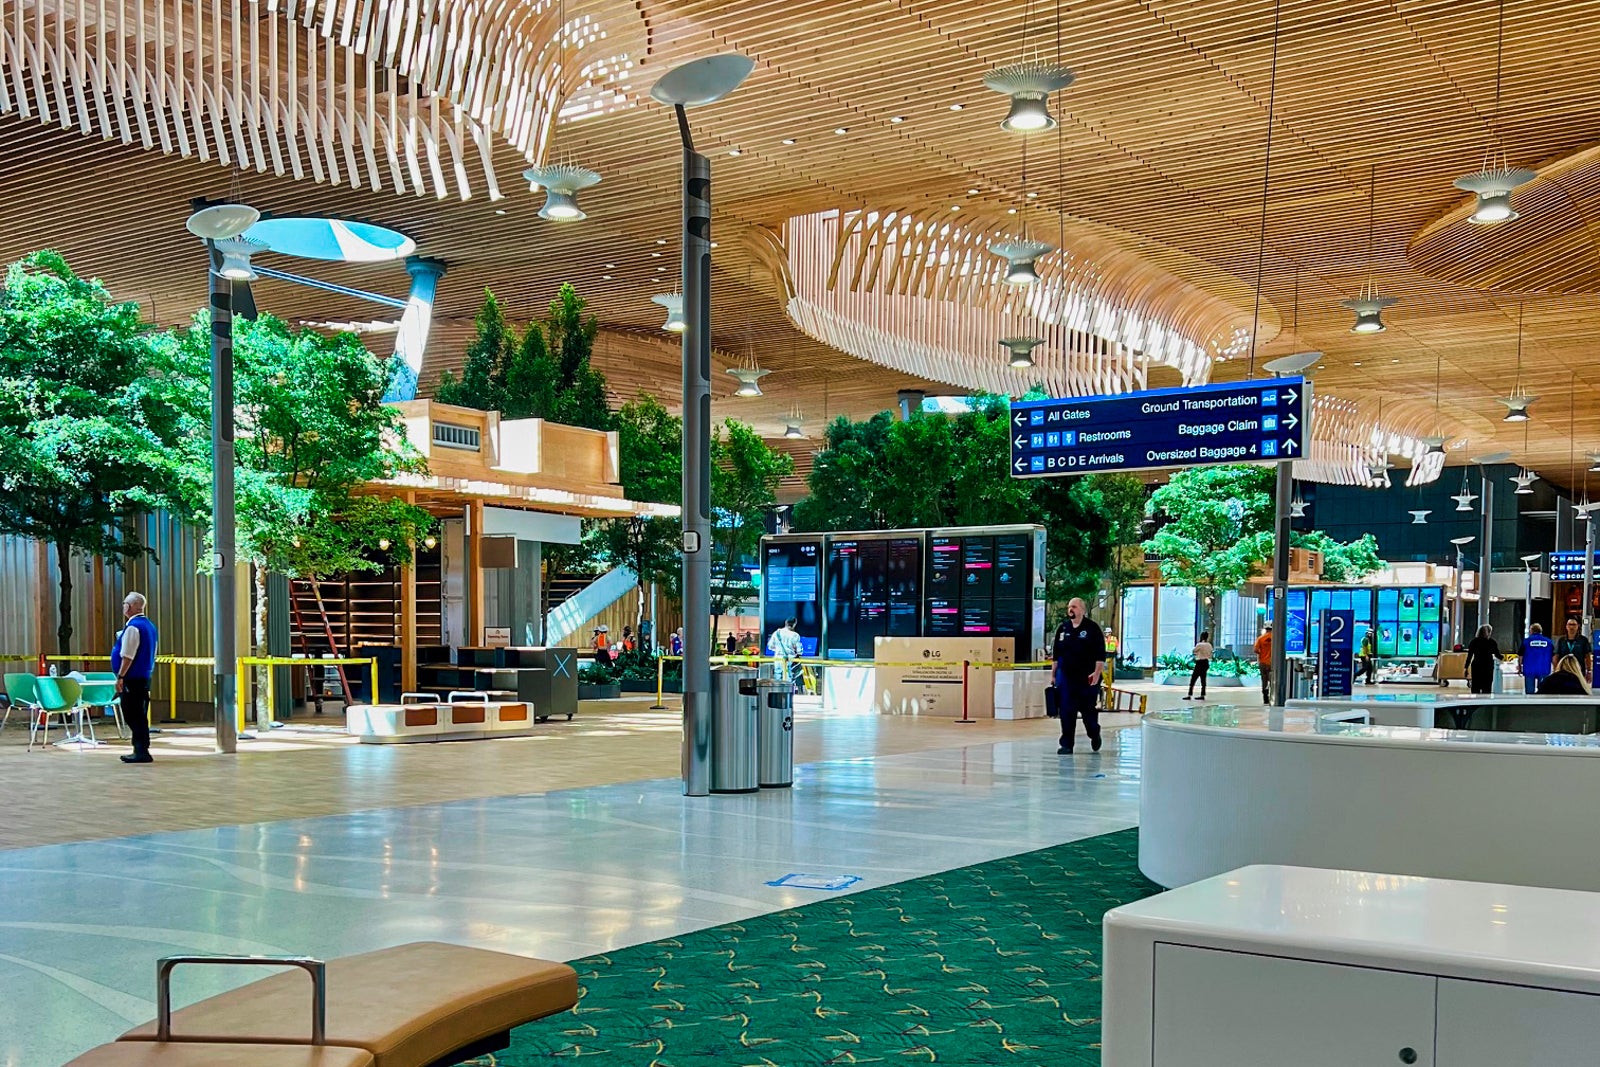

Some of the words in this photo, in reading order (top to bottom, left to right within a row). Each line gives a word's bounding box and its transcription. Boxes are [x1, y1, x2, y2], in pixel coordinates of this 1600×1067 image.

[1141, 401, 1180, 414] Ground
[1182, 396, 1257, 410] Transportation
[1048, 411, 1060, 422] All
[1062, 410, 1091, 420] Gates
[1079, 430, 1132, 442] Restrooms
[1178, 423, 1225, 436] Baggage
[1227, 420, 1258, 432] Claim
[1048, 457, 1056, 468] B
[1057, 456, 1066, 467] C
[1068, 455, 1077, 466] D
[1078, 455, 1087, 466] E
[1088, 453, 1125, 465] Arrivals
[1146, 448, 1197, 461] Oversized
[1199, 446, 1247, 459] Baggage
[1249, 444, 1257, 454] 4
[1330, 616, 1345, 642] 2
